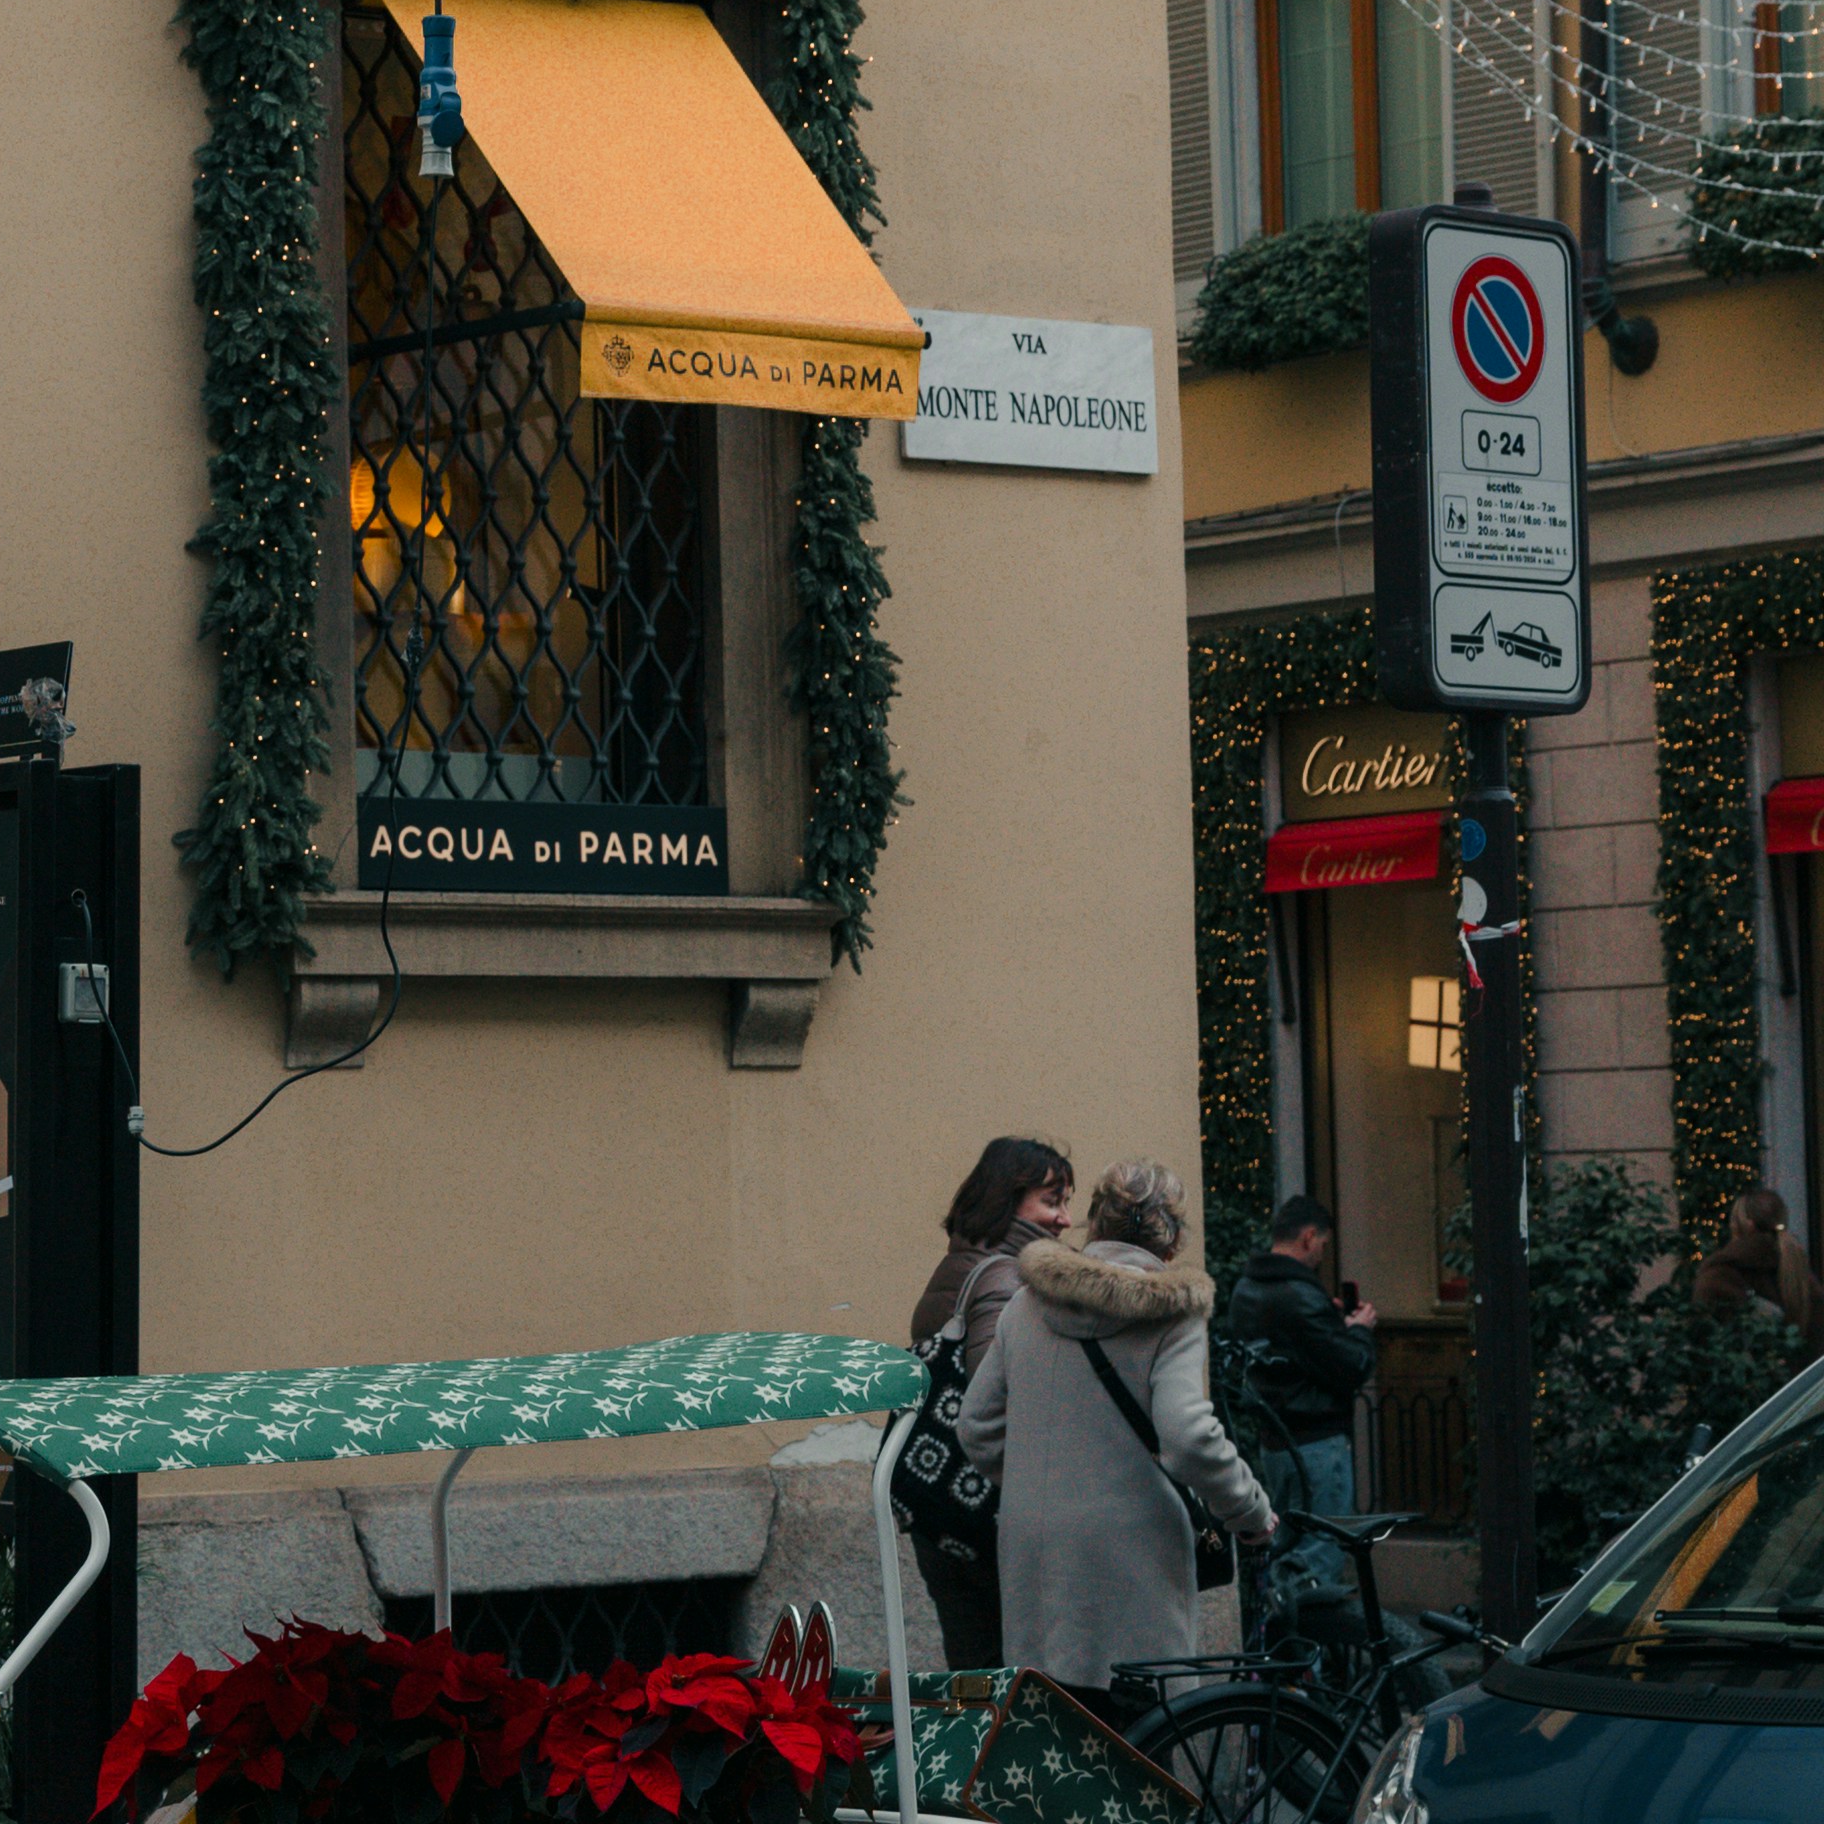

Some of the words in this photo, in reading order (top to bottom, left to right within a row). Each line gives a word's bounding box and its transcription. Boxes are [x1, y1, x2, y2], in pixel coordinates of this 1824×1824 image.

[1012, 332, 1047, 355] VIA
[647, 347, 759, 380] ACQUA
[771, 365, 791, 384] DI
[803, 360, 904, 395] PARMA
[917, 385, 998, 422] MONTE
[1008, 391, 1148, 433] NAPOLEONE
[1486, 482, 1523, 494] eccetto:
[1301, 734, 1451, 797] Cartier
[369, 824, 515, 863] ACQUA
[534, 840, 562, 864] DI
[579, 830, 719, 867] PARMA
[1299, 842, 1405, 887] Cartier
